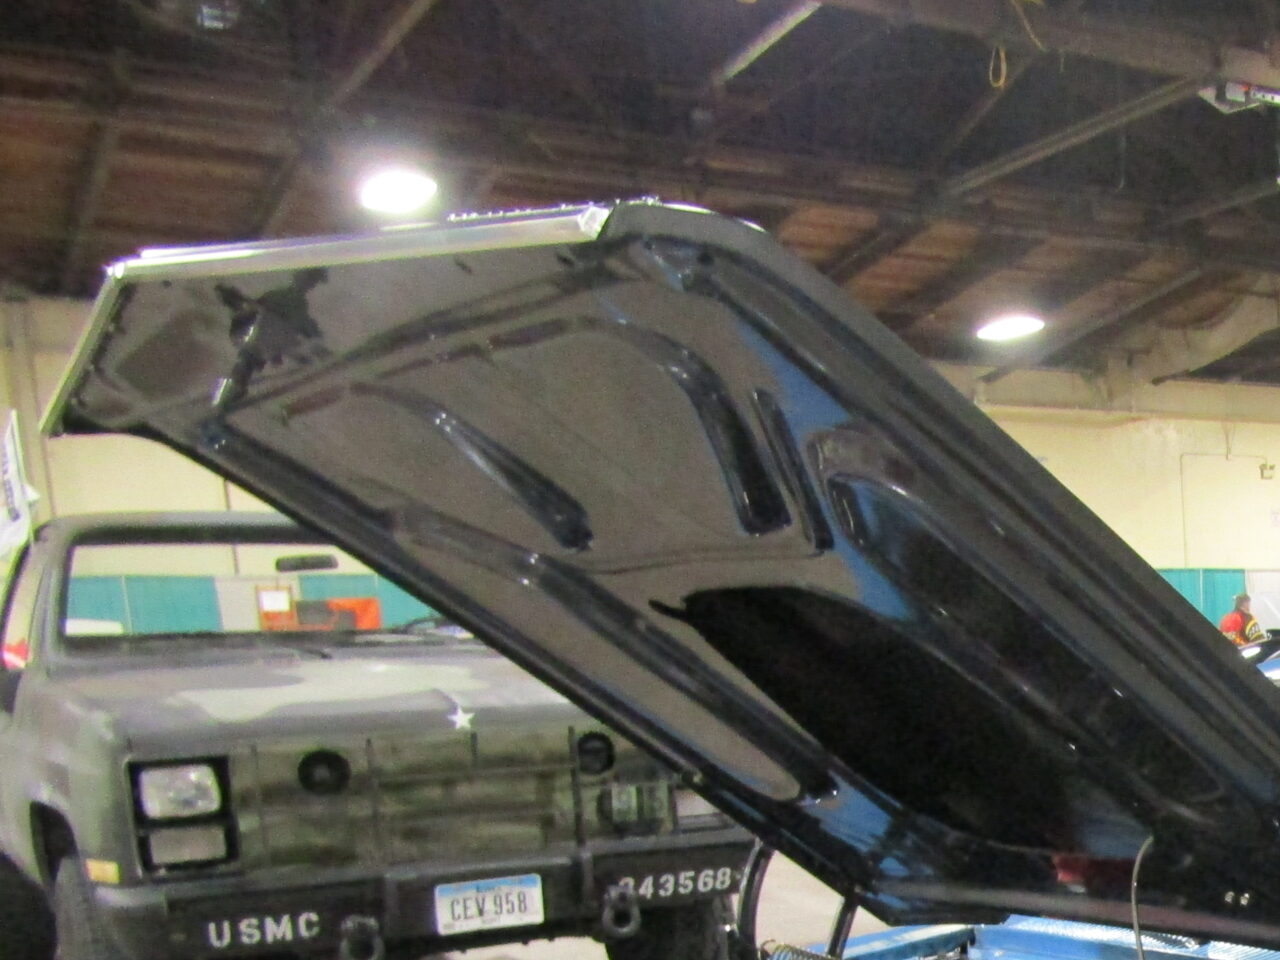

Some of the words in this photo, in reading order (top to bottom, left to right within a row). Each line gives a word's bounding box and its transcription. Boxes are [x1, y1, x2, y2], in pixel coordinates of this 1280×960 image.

[450, 896, 487, 921] CEV
[493, 890, 528, 916] 958
[208, 911, 320, 949] USMC
